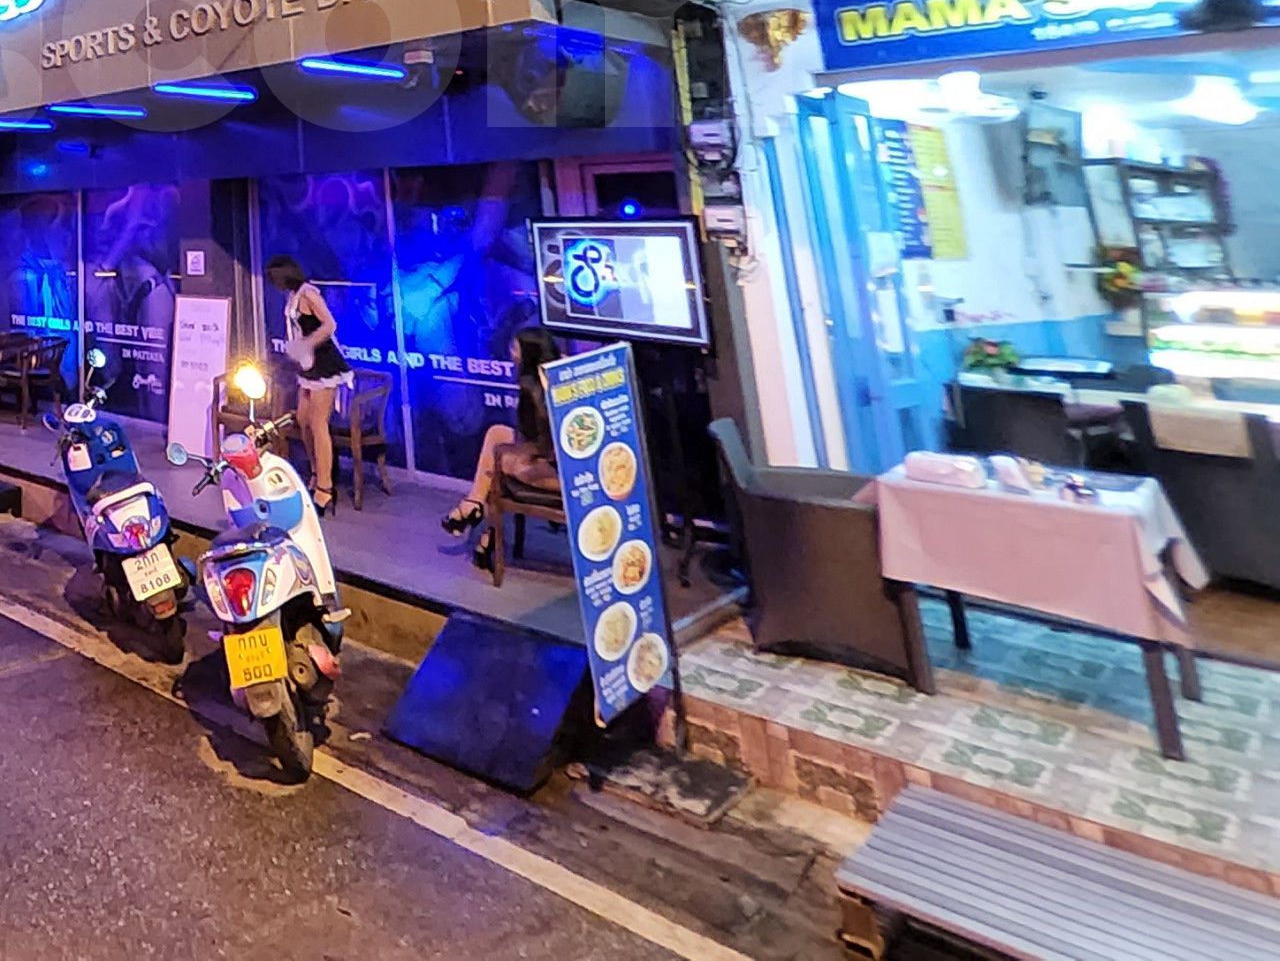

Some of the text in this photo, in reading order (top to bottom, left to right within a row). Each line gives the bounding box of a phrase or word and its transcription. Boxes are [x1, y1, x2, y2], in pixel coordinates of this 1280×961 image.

[41, 23, 136, 70] SPORTS
[142, 16, 164, 46] &
[271, 338, 516, 378] TH GIRLS AND THE BEST
[140, 573, 171, 594] 8108
